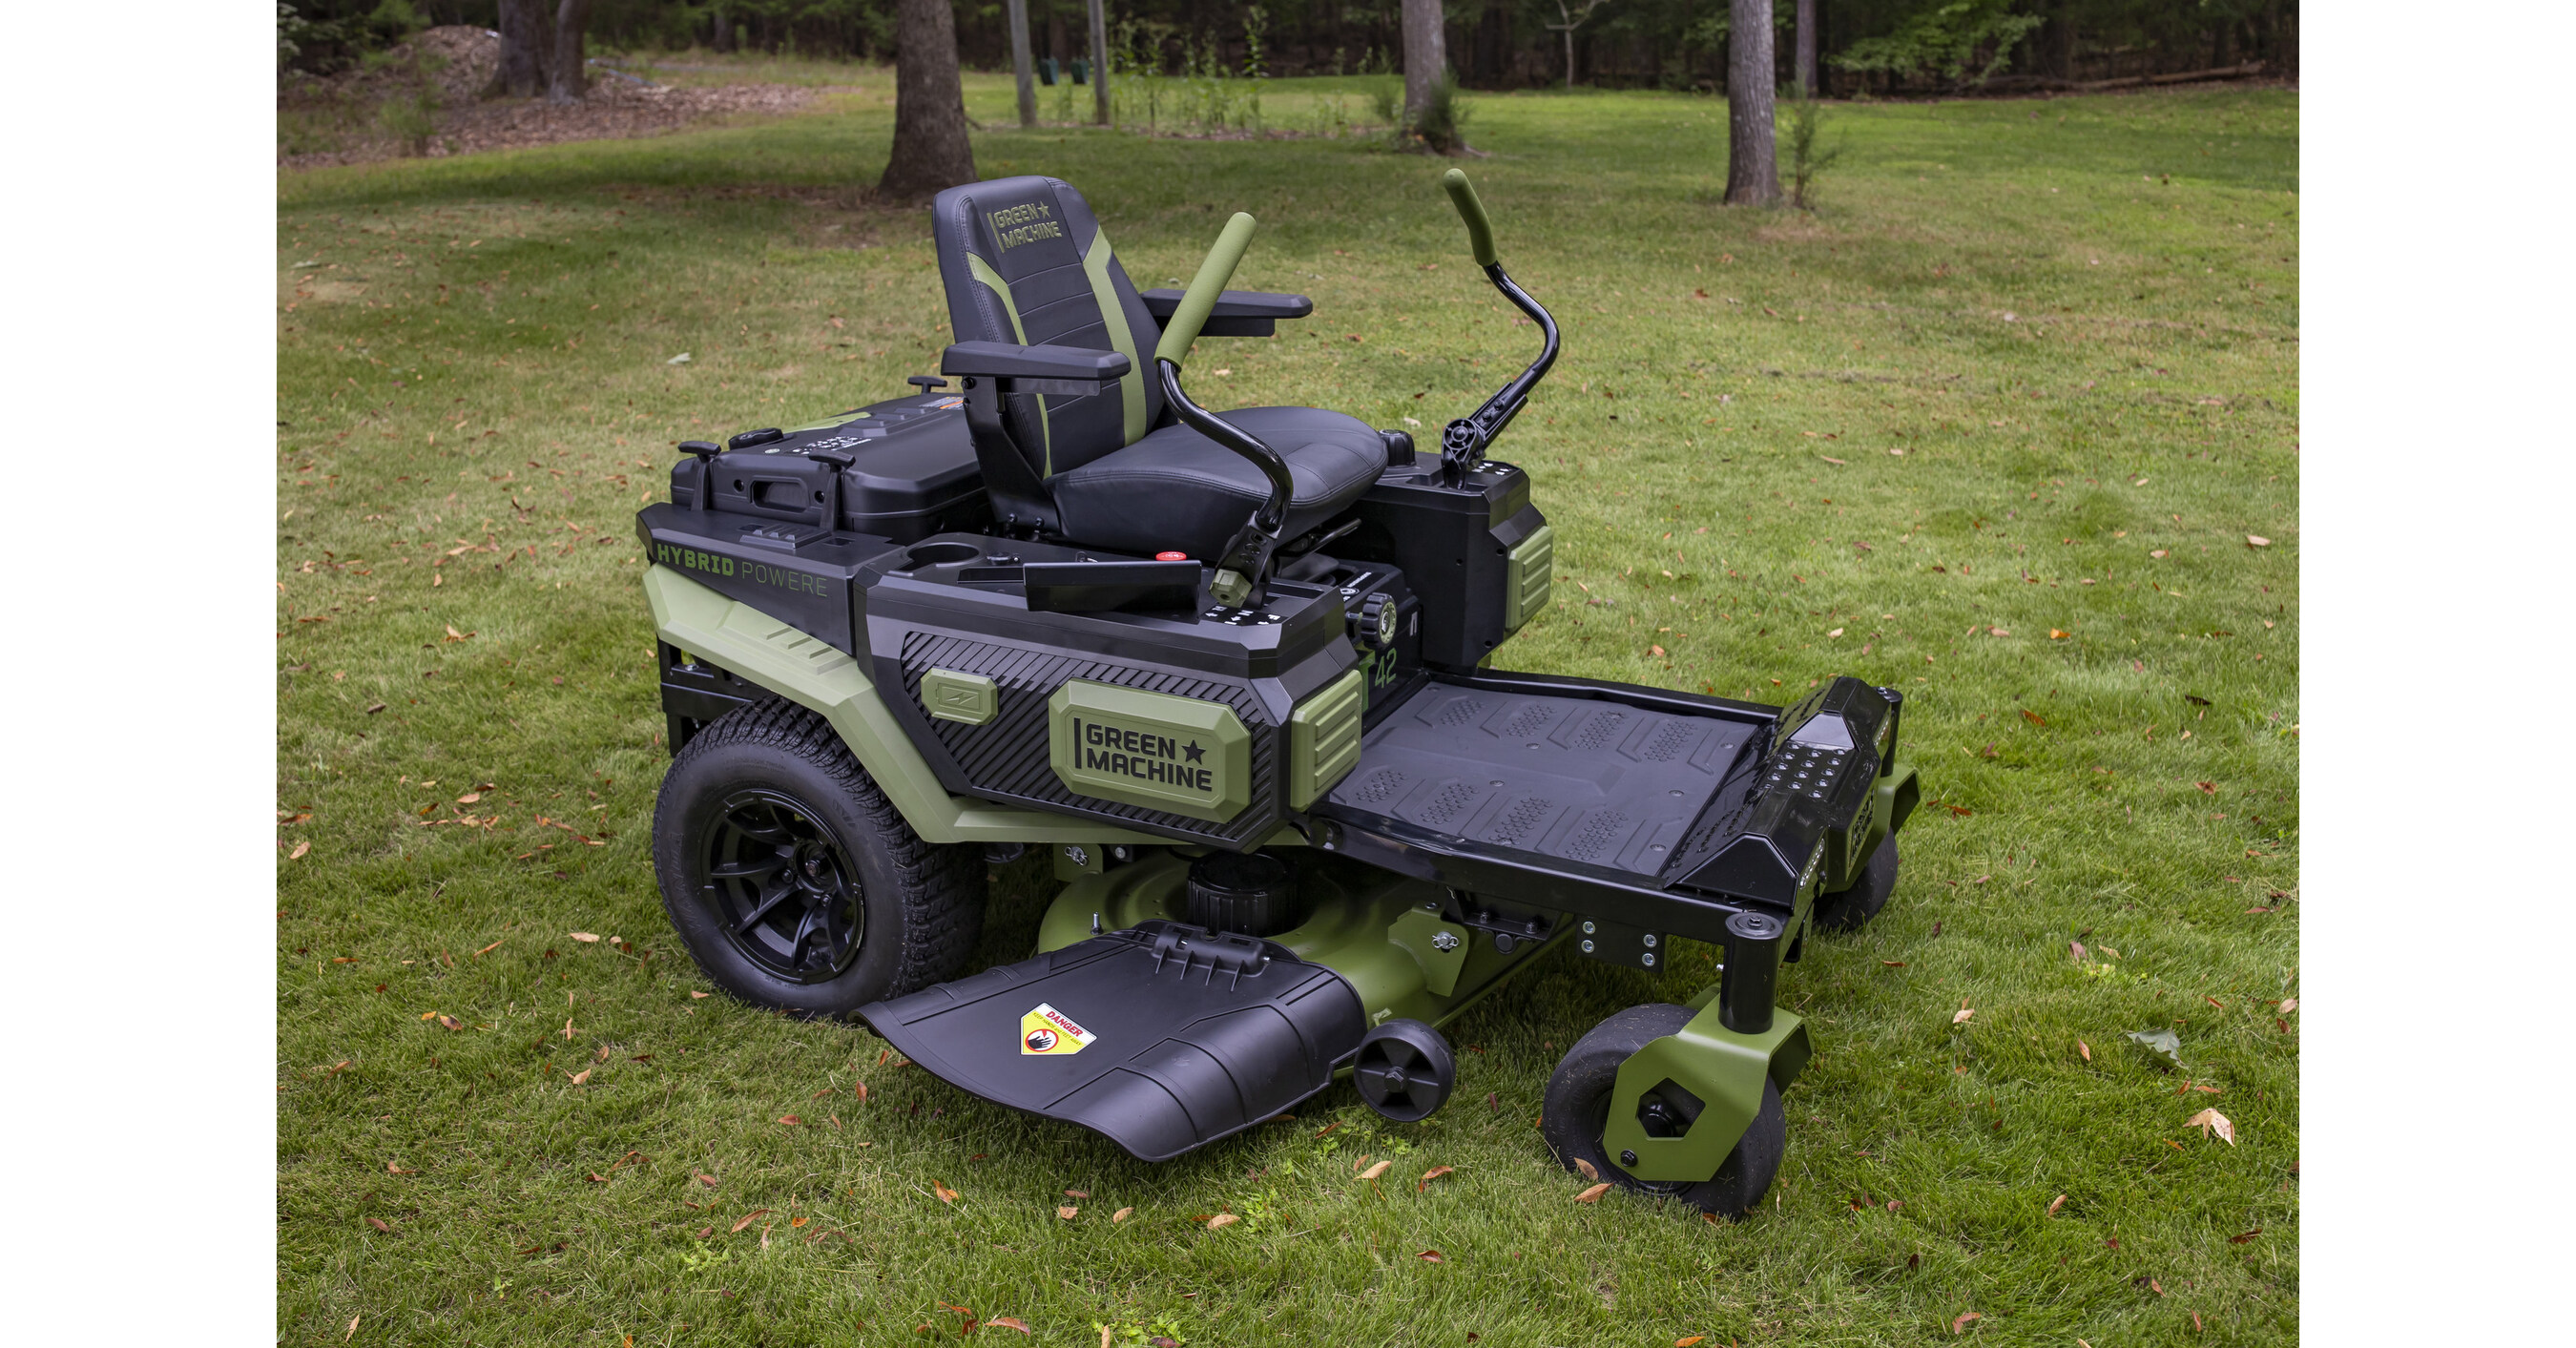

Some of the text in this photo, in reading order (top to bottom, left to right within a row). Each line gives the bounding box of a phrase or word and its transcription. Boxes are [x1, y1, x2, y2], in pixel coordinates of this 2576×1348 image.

[994, 203, 1040, 228] GREEN
[1001, 220, 1063, 249] MACHINE
[657, 544, 828, 598] HYBRID POWERE
[1375, 647, 1398, 689] 42
[1086, 723, 1176, 760] GREEN
[1087, 748, 1213, 792] MACHINE
[1046, 1010, 1084, 1037] DANGER
